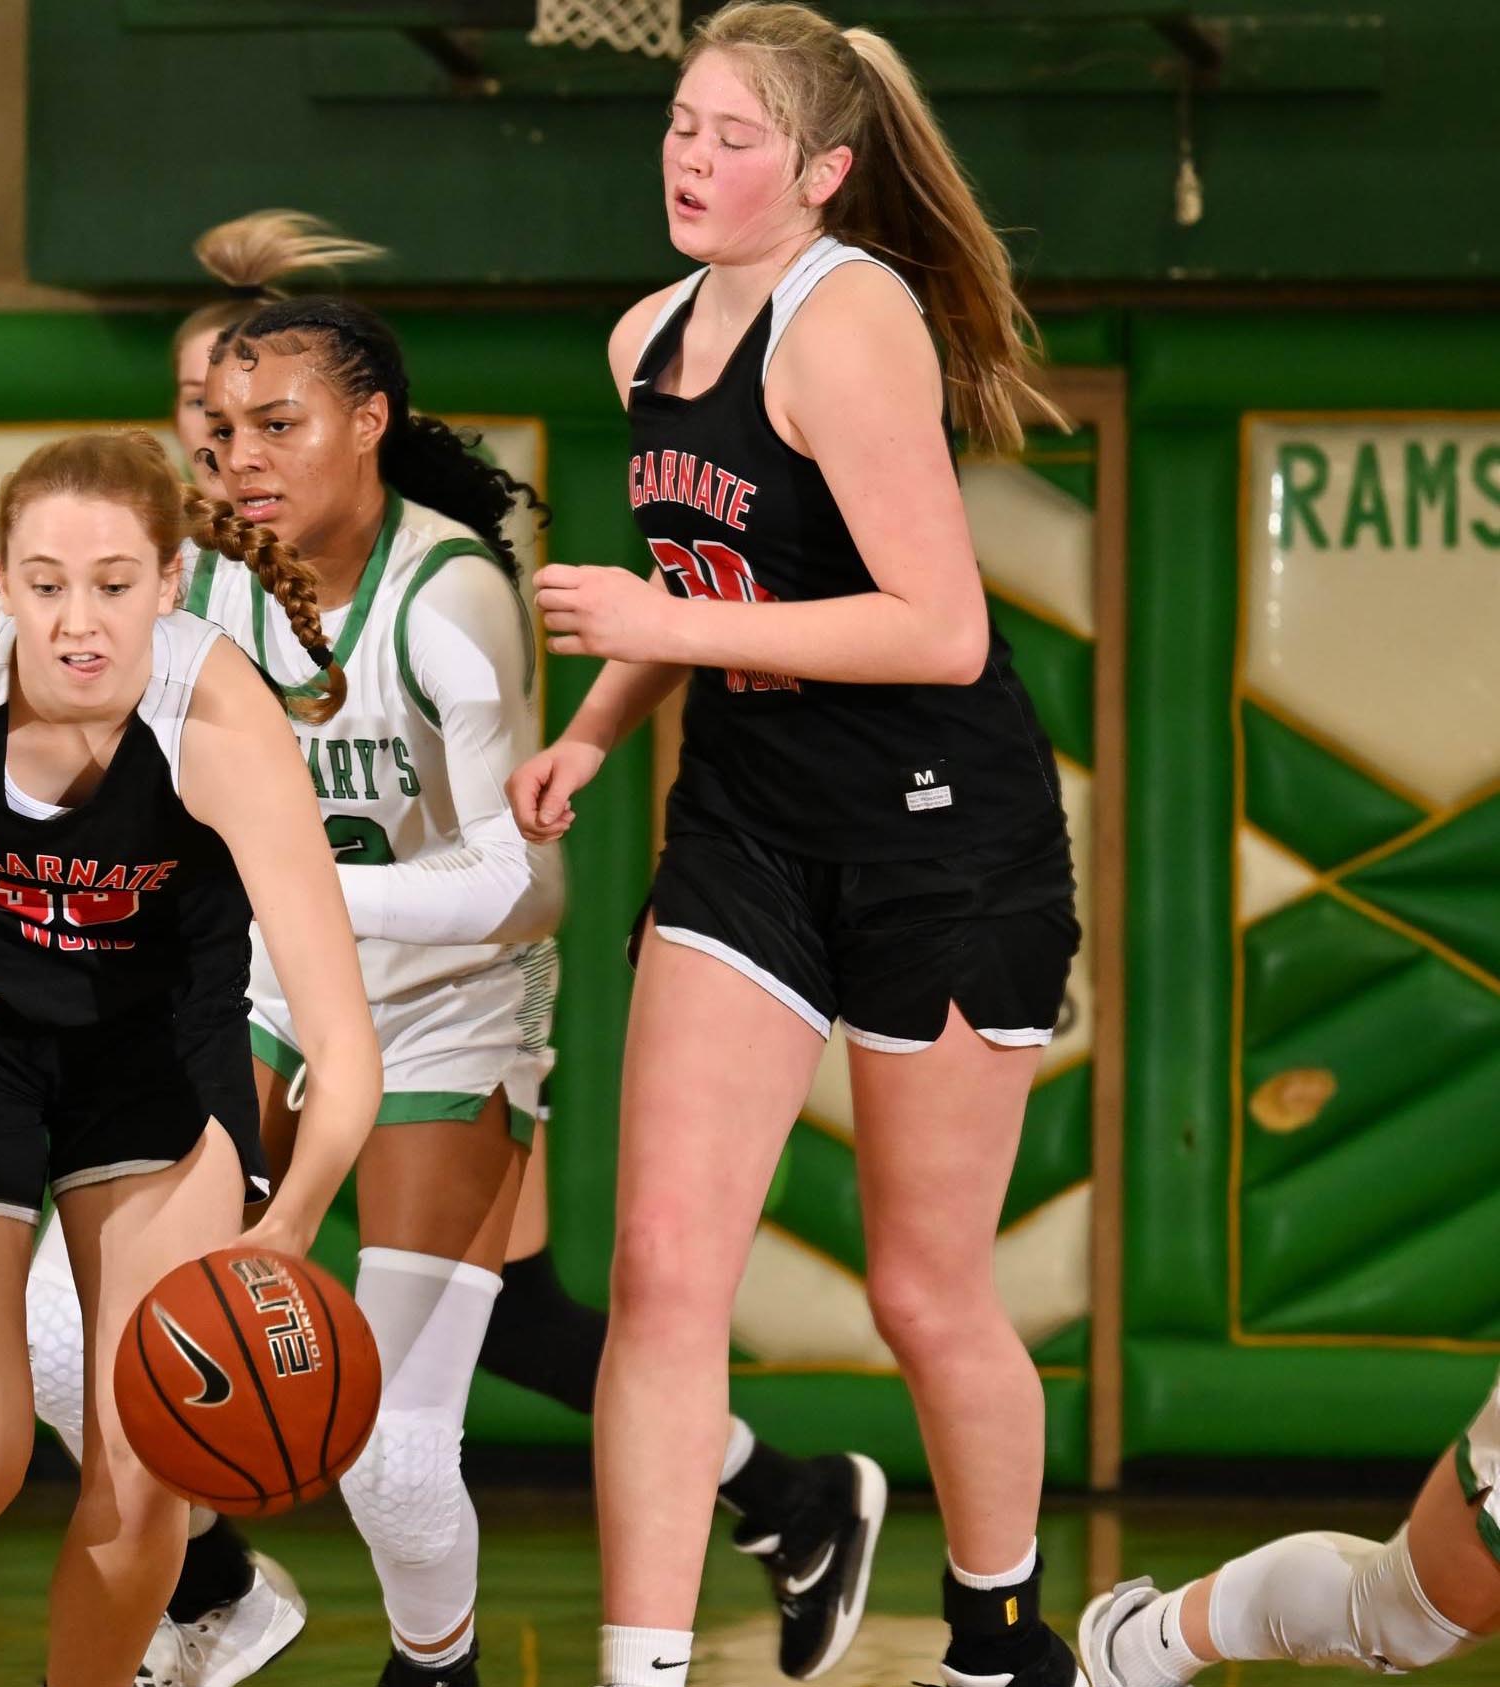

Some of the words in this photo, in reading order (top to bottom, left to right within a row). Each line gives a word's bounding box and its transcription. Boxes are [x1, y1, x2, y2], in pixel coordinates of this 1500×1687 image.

[627, 449, 757, 531] CARNATE
[297, 736, 421, 800] ARY'S
[913, 769, 935, 786] M
[227, 1257, 312, 1377] ELITE
